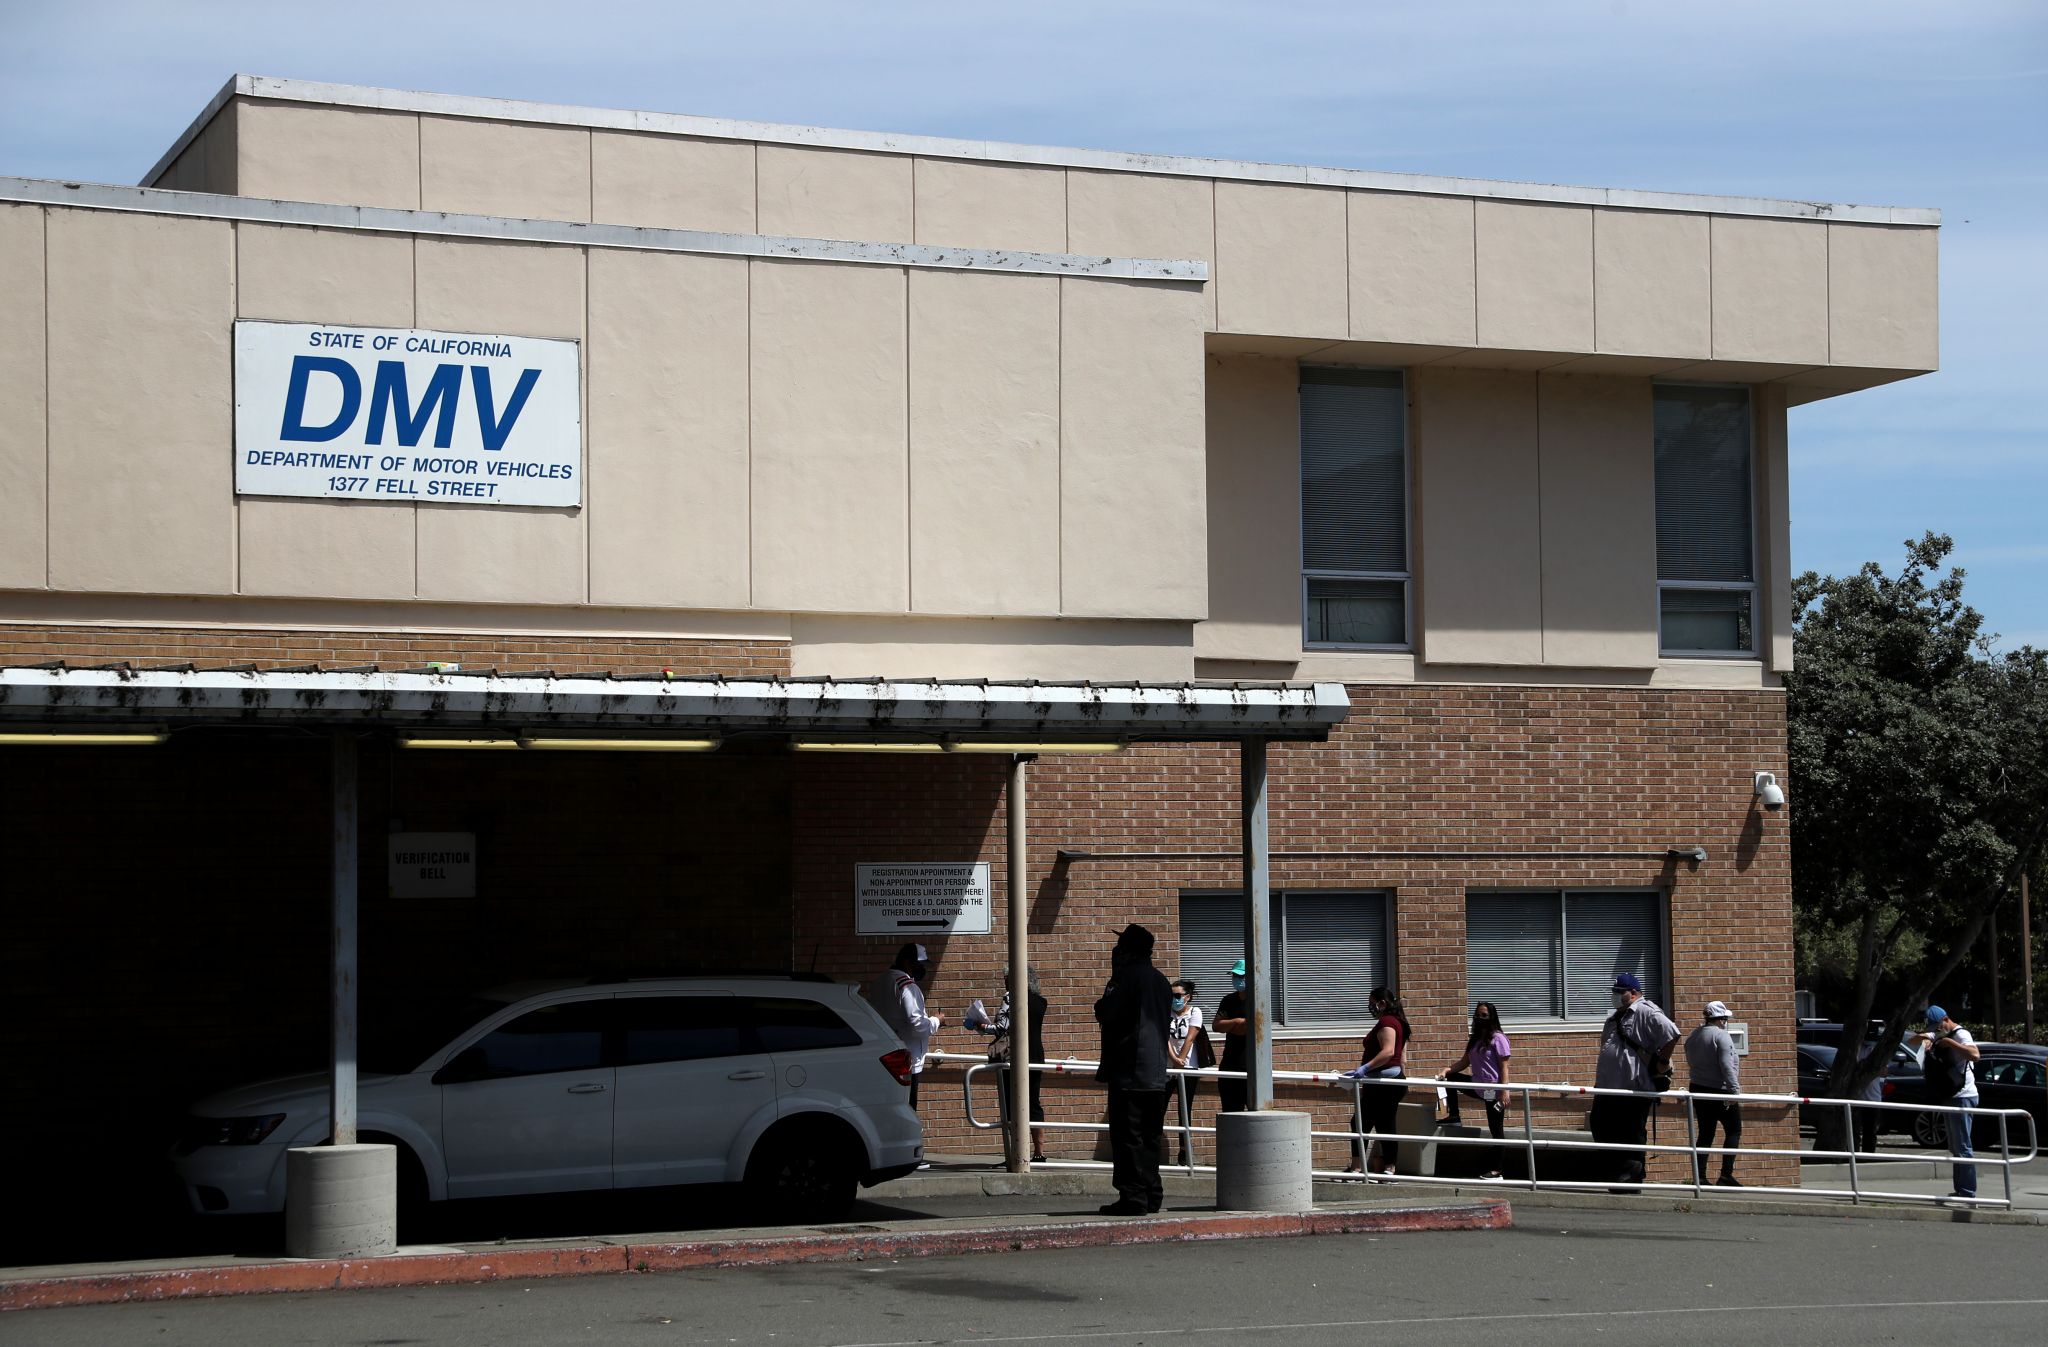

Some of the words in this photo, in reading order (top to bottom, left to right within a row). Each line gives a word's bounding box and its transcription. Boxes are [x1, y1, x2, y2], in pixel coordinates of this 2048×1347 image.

[309, 331, 364, 349] STATE
[373, 335, 399, 351] OF
[406, 337, 512, 358] CALIFORNIA
[279, 354, 543, 451] DMV
[247, 450, 373, 470] DEPARTMENT
[380, 455, 407, 472] OF
[413, 458, 478, 475] MOTOR
[486, 461, 573, 480] VEHICLES
[328, 476, 368, 492] 1377
[375, 478, 419, 494] FELL
[427, 481, 498, 498] STREET
[395, 852, 470, 864] VERIFICATION
[420, 868, 446, 879] BELL
